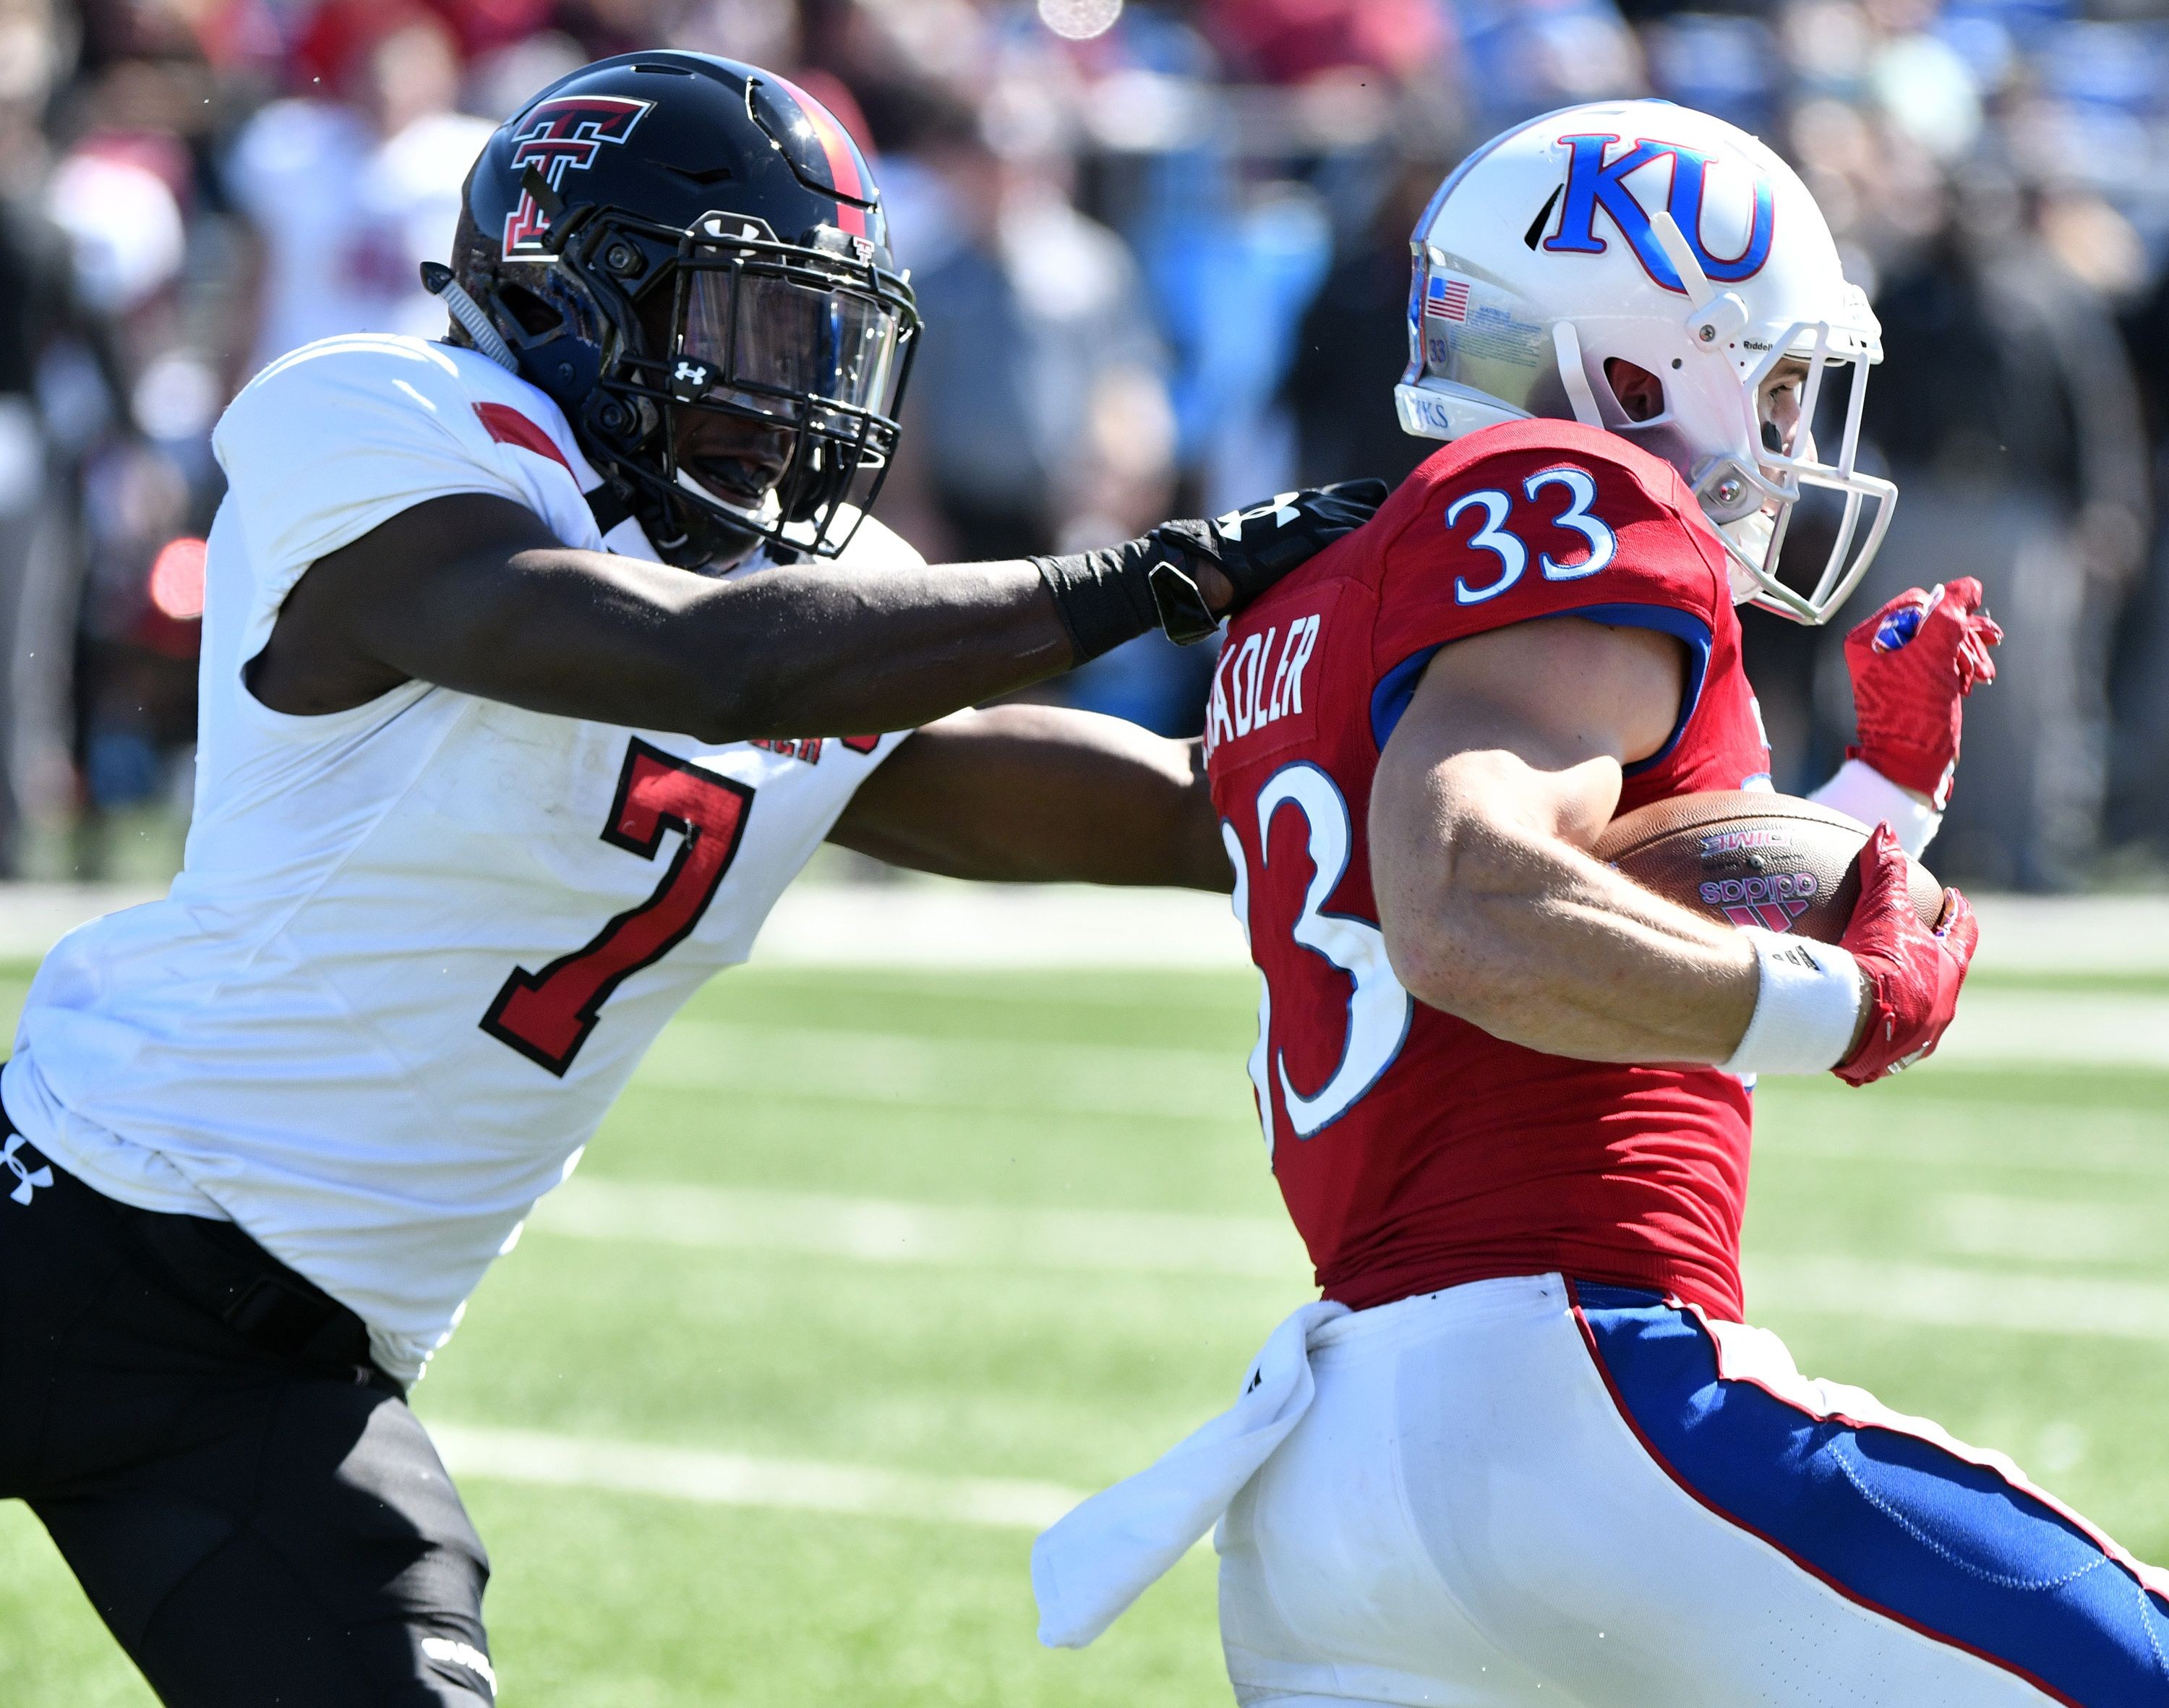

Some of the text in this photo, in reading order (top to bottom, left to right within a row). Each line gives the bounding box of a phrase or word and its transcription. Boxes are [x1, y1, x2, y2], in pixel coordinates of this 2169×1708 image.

[1544, 133, 1774, 295] KU
[1446, 467, 1617, 606] 33
[478, 735, 757, 1079] 7
[1699, 871, 1819, 907] adidas
[1700, 830, 1789, 859] DIME
